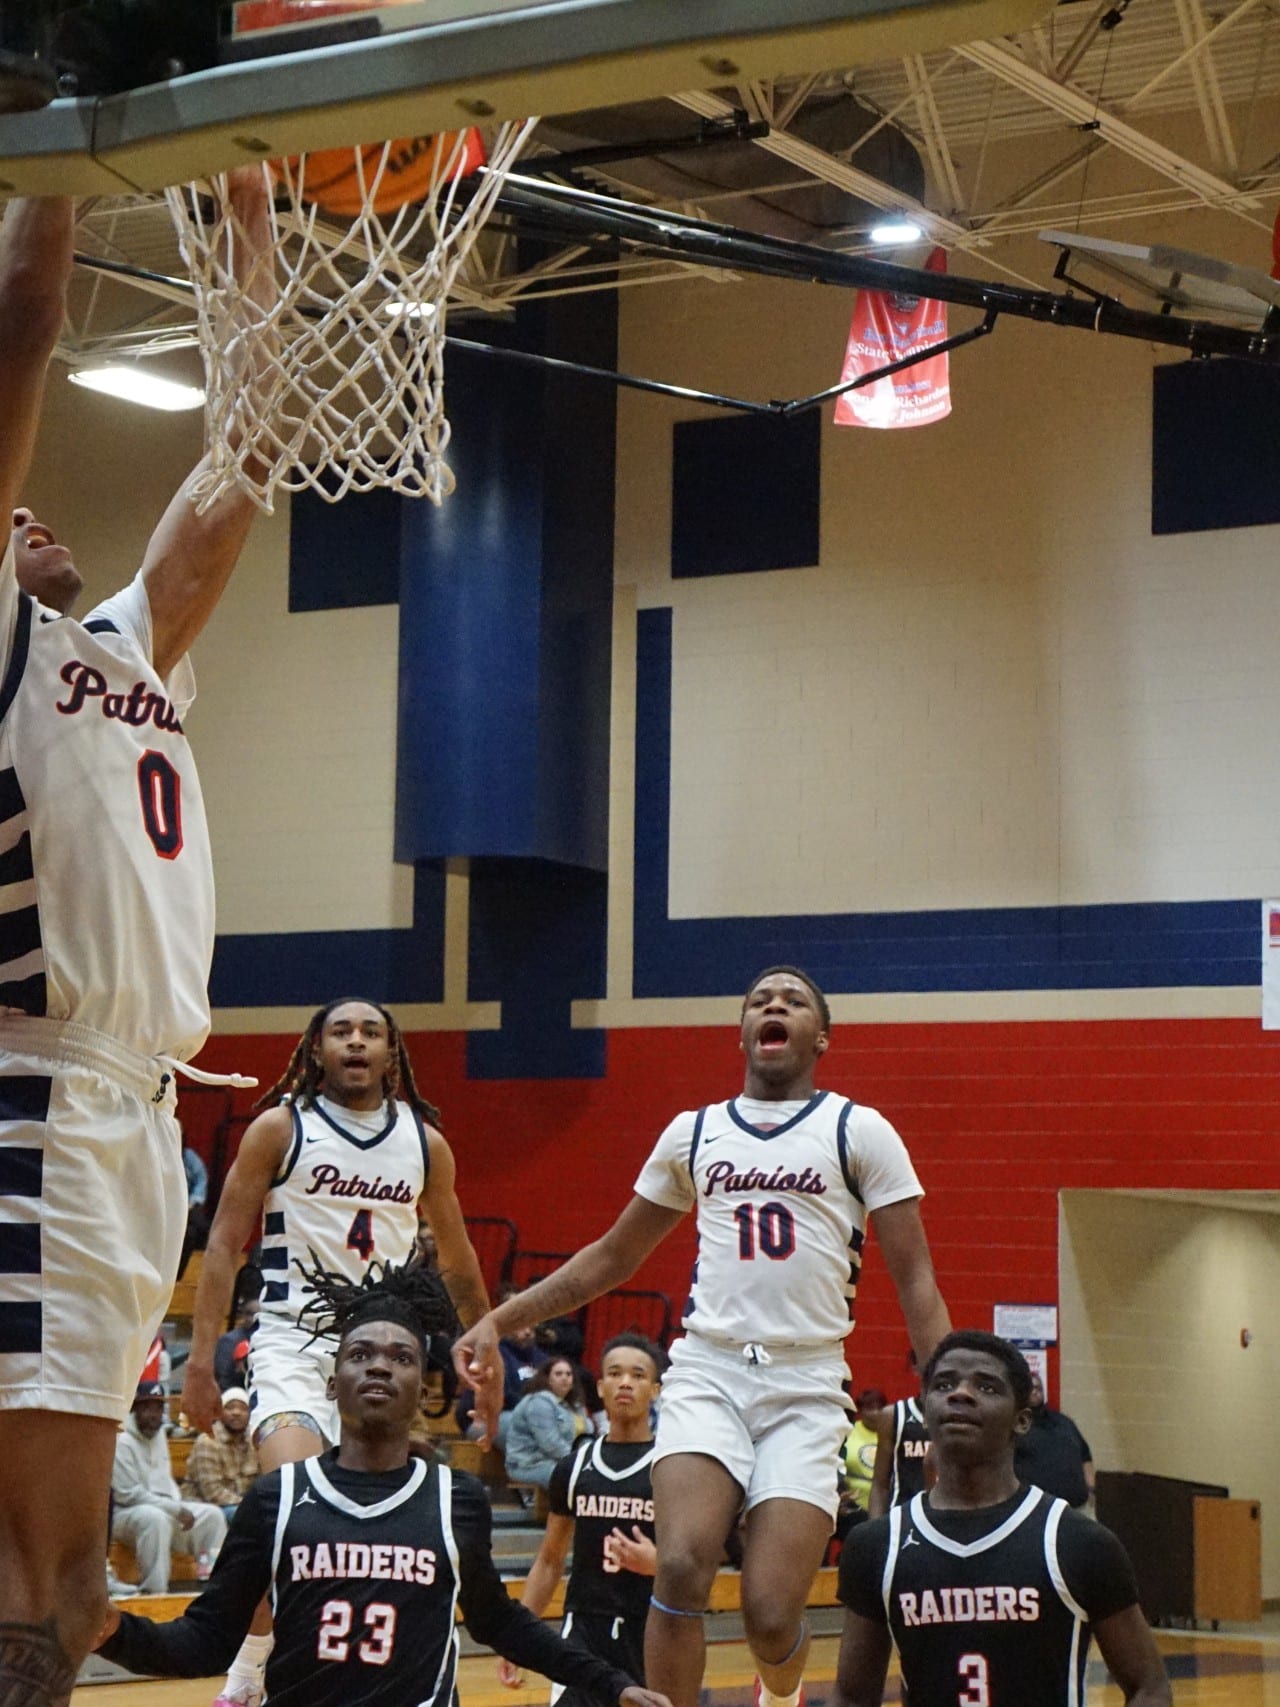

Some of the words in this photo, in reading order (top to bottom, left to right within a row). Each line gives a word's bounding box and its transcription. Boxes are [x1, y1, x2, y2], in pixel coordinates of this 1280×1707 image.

[137, 749, 184, 860] 0
[305, 1163, 414, 1204] Patriots
[704, 1160, 827, 1197] Patriots
[346, 1208, 375, 1262] 4
[733, 1201, 796, 1261] 10
[575, 1494, 656, 1522] RAIDERS
[289, 1542, 437, 1586] RAIDERS
[898, 1586, 1040, 1627] RAIDERS
[317, 1600, 398, 1666] 23
[957, 1653, 991, 1707] 3
